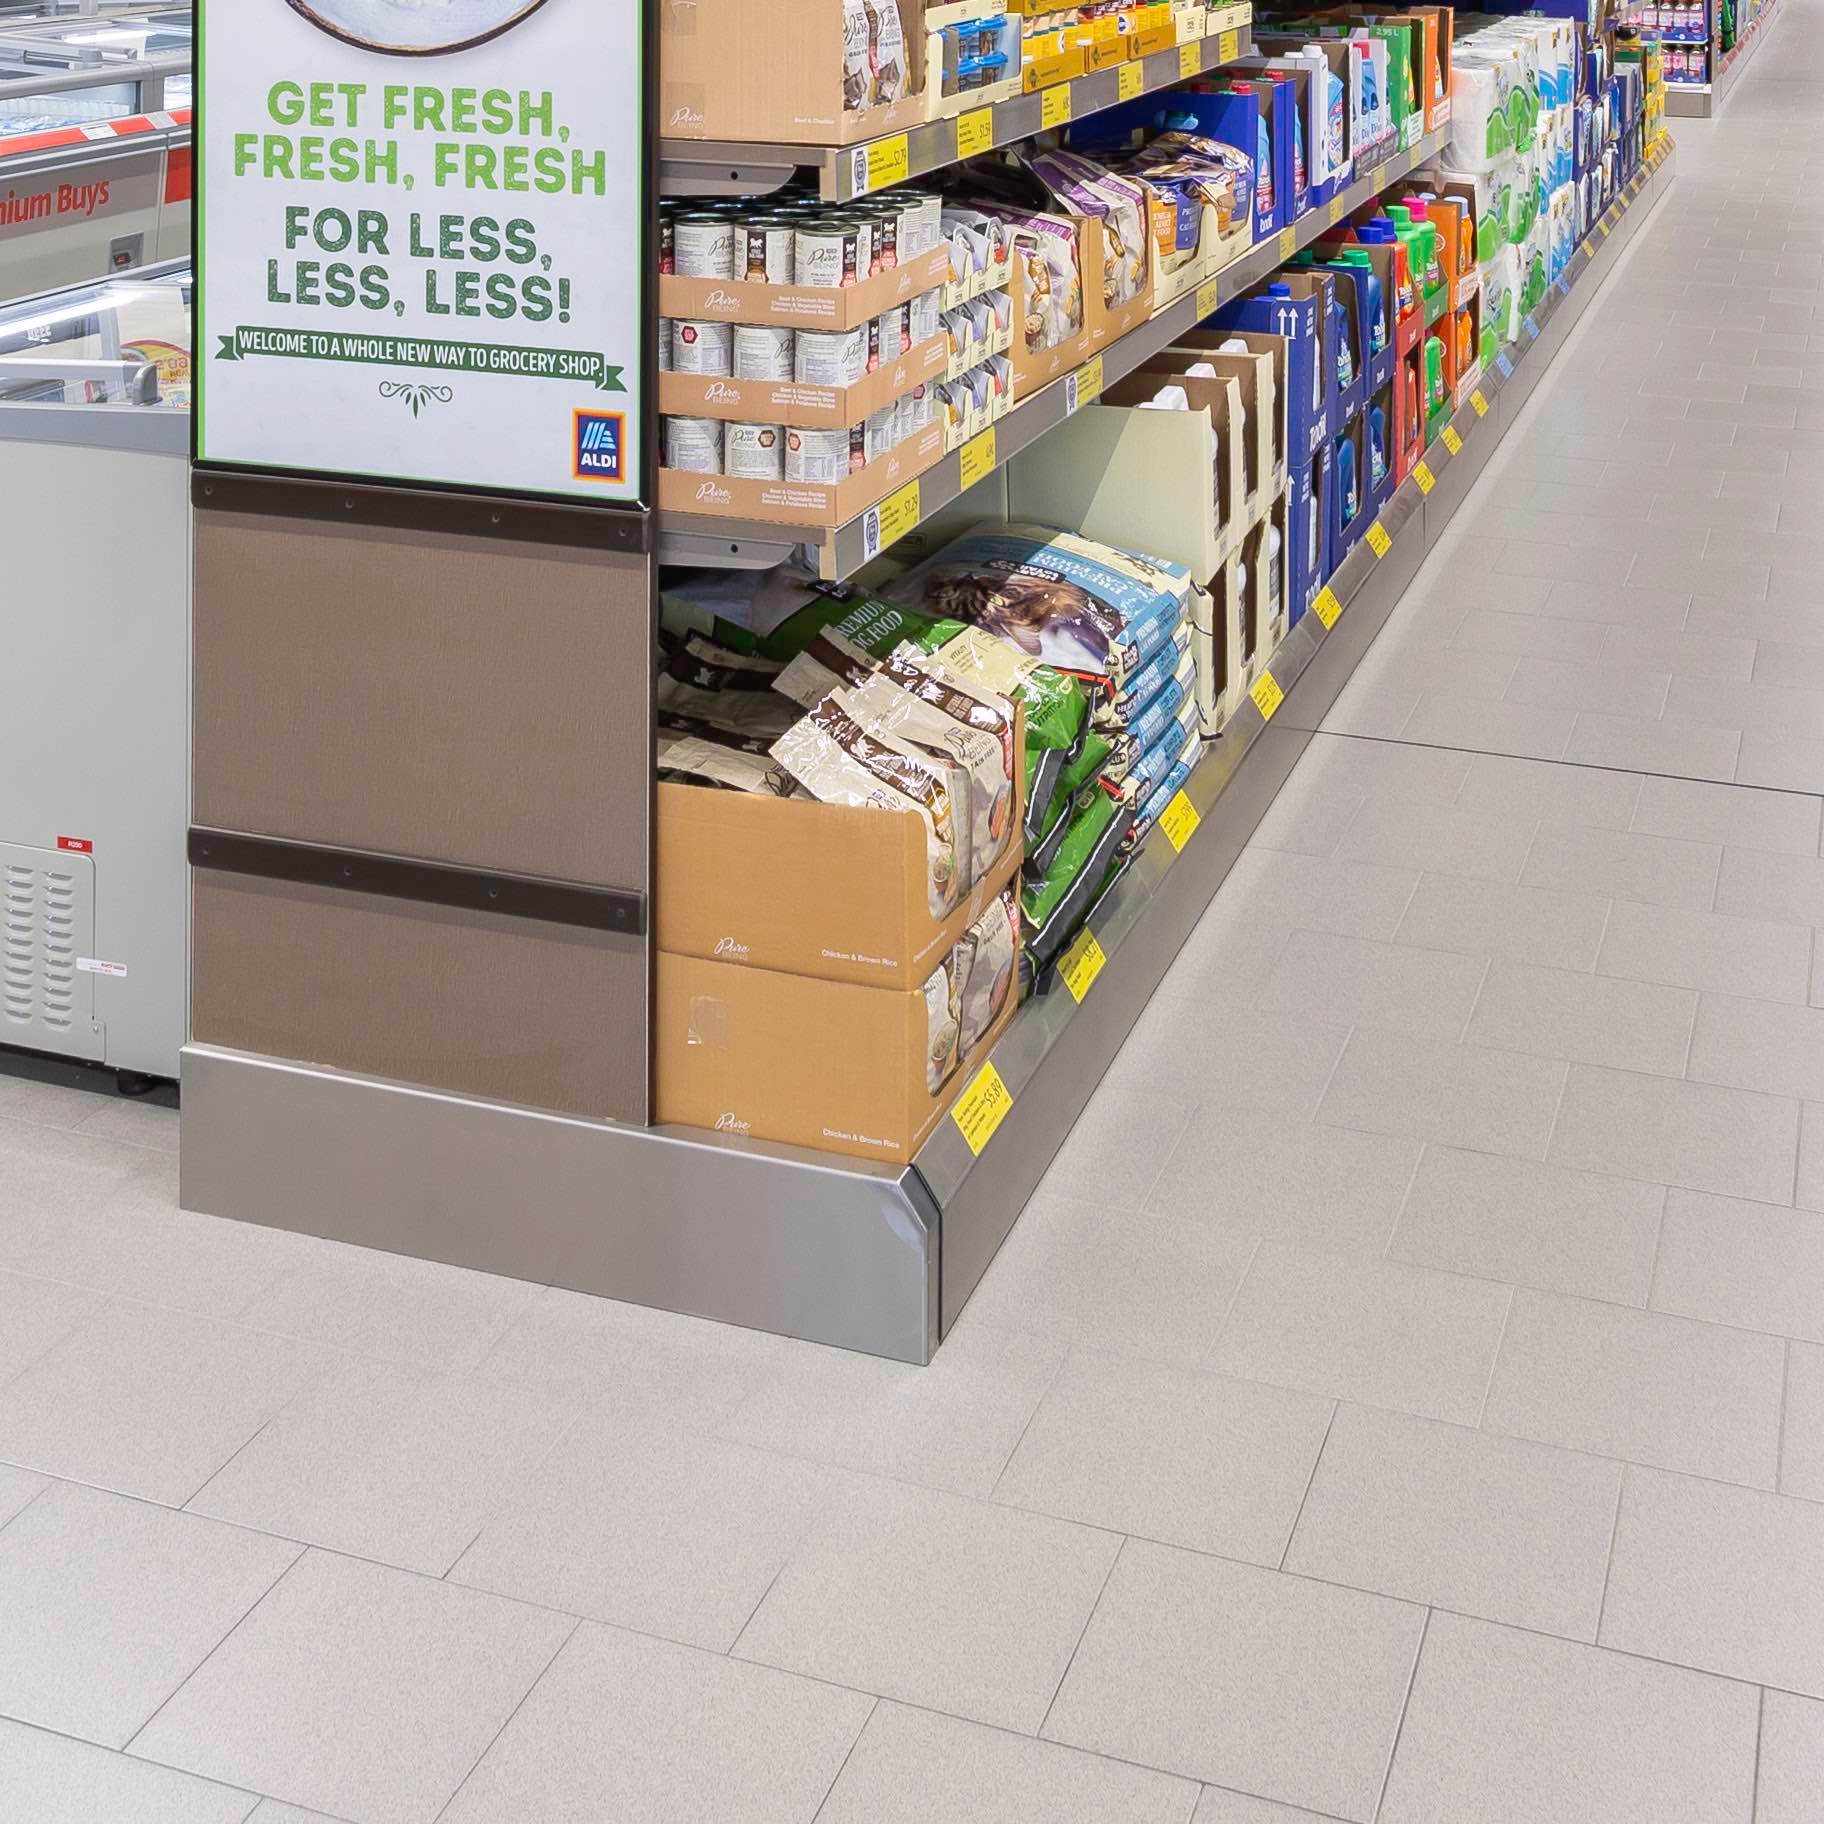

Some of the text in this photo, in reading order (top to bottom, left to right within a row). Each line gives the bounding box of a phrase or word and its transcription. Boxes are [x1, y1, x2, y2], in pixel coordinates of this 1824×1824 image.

[267, 80, 571, 143] GET FRESH,
[234, 133, 607, 196] FRESH, FRESH
[57, 178, 111, 216] Buys
[285, 206, 553, 272] FOR LESS,
[267, 259, 571, 324] LESS, LESS!
[238, 329, 604, 378] WELCOME TO A WHOLE NEW WAY TO GROCERY SHOP.
[580, 452, 618, 469] ALDI
[866, 610, 903, 641] FOOD
[821, 949, 851, 960] Chicken
[881, 958, 898, 968] Rice
